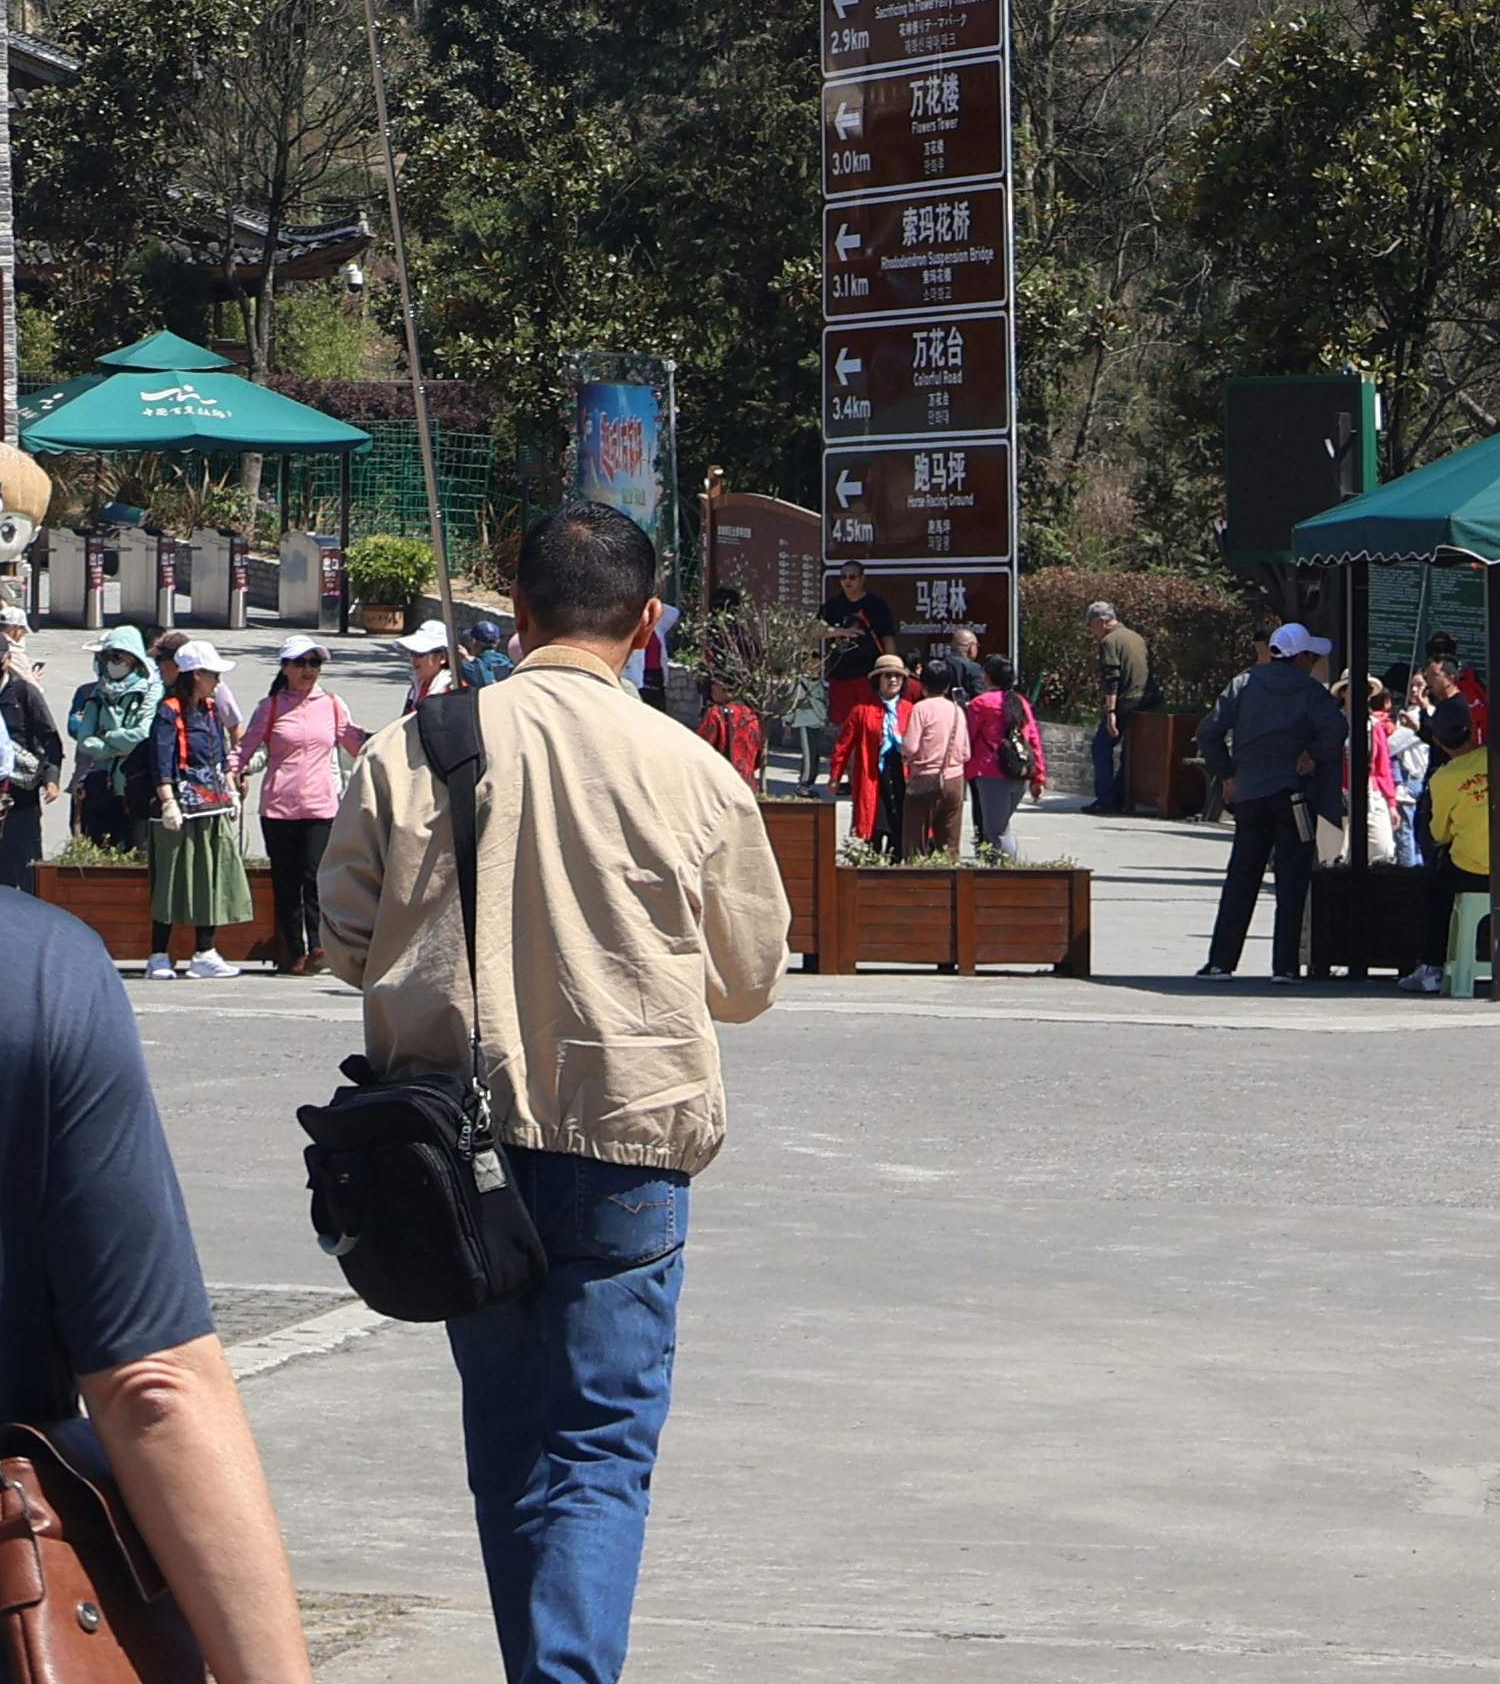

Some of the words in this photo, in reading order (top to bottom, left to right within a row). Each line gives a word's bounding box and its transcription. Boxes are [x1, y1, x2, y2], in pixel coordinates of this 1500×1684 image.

[830, 30, 870, 54] 2.9km
[909, 73, 960, 118] 万花楼
[911, 121, 937, 134] Flowers
[937, 118, 959, 132] Tower
[832, 150, 871, 175] 3.0km
[902, 200, 970, 247] 索玛花桥
[969, 246, 995, 265] Bridge
[832, 273, 869, 298] 3.1km
[912, 326, 964, 368] 万花台
[913, 371, 942, 387] Colorful
[943, 369, 963, 385] Road
[832, 396, 871, 420] 3.4km
[913, 451, 966, 492] 跑马坪
[949, 492, 974, 506] Ground
[832, 518, 873, 542] 4.5km
[915, 579, 967, 620] 马缨林
